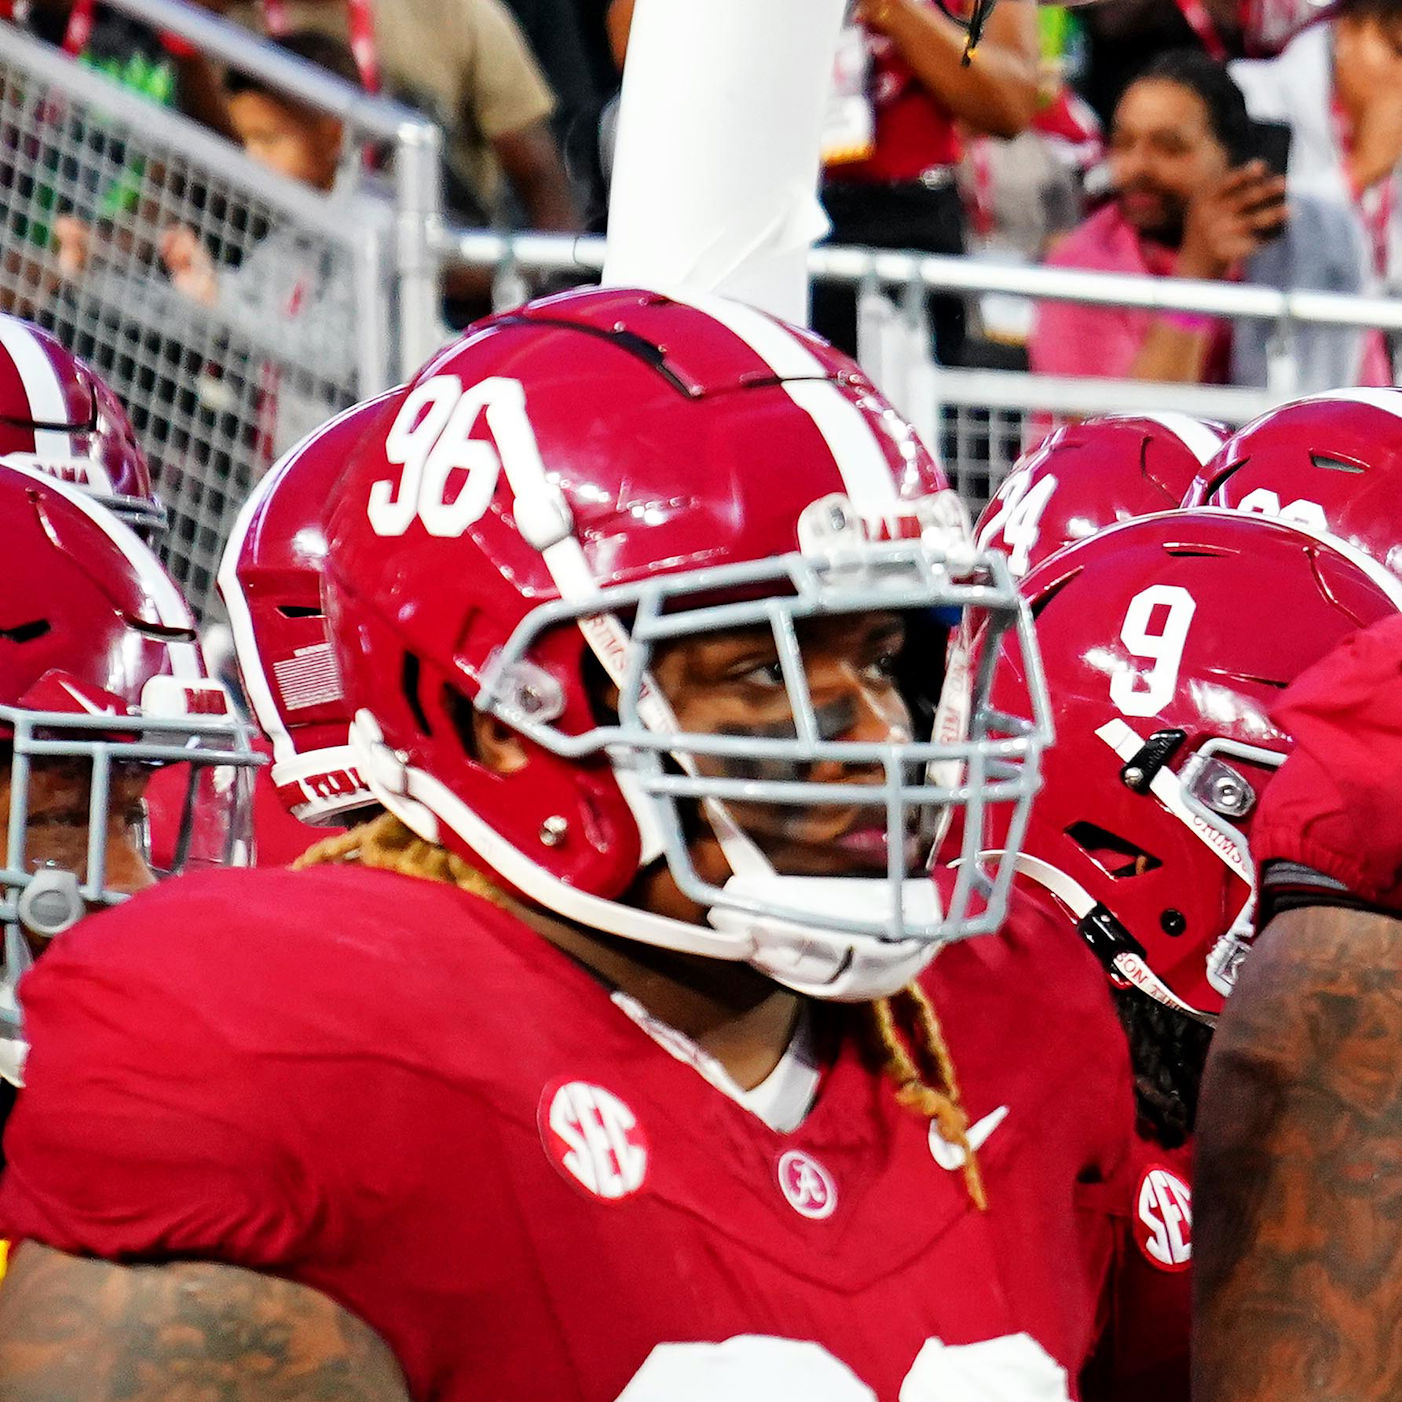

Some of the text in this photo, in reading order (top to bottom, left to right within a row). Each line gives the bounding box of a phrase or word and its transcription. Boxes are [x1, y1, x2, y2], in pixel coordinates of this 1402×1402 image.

[367, 374, 528, 537] 96
[1108, 584, 1197, 717] 9
[549, 1079, 648, 1199] SEC
